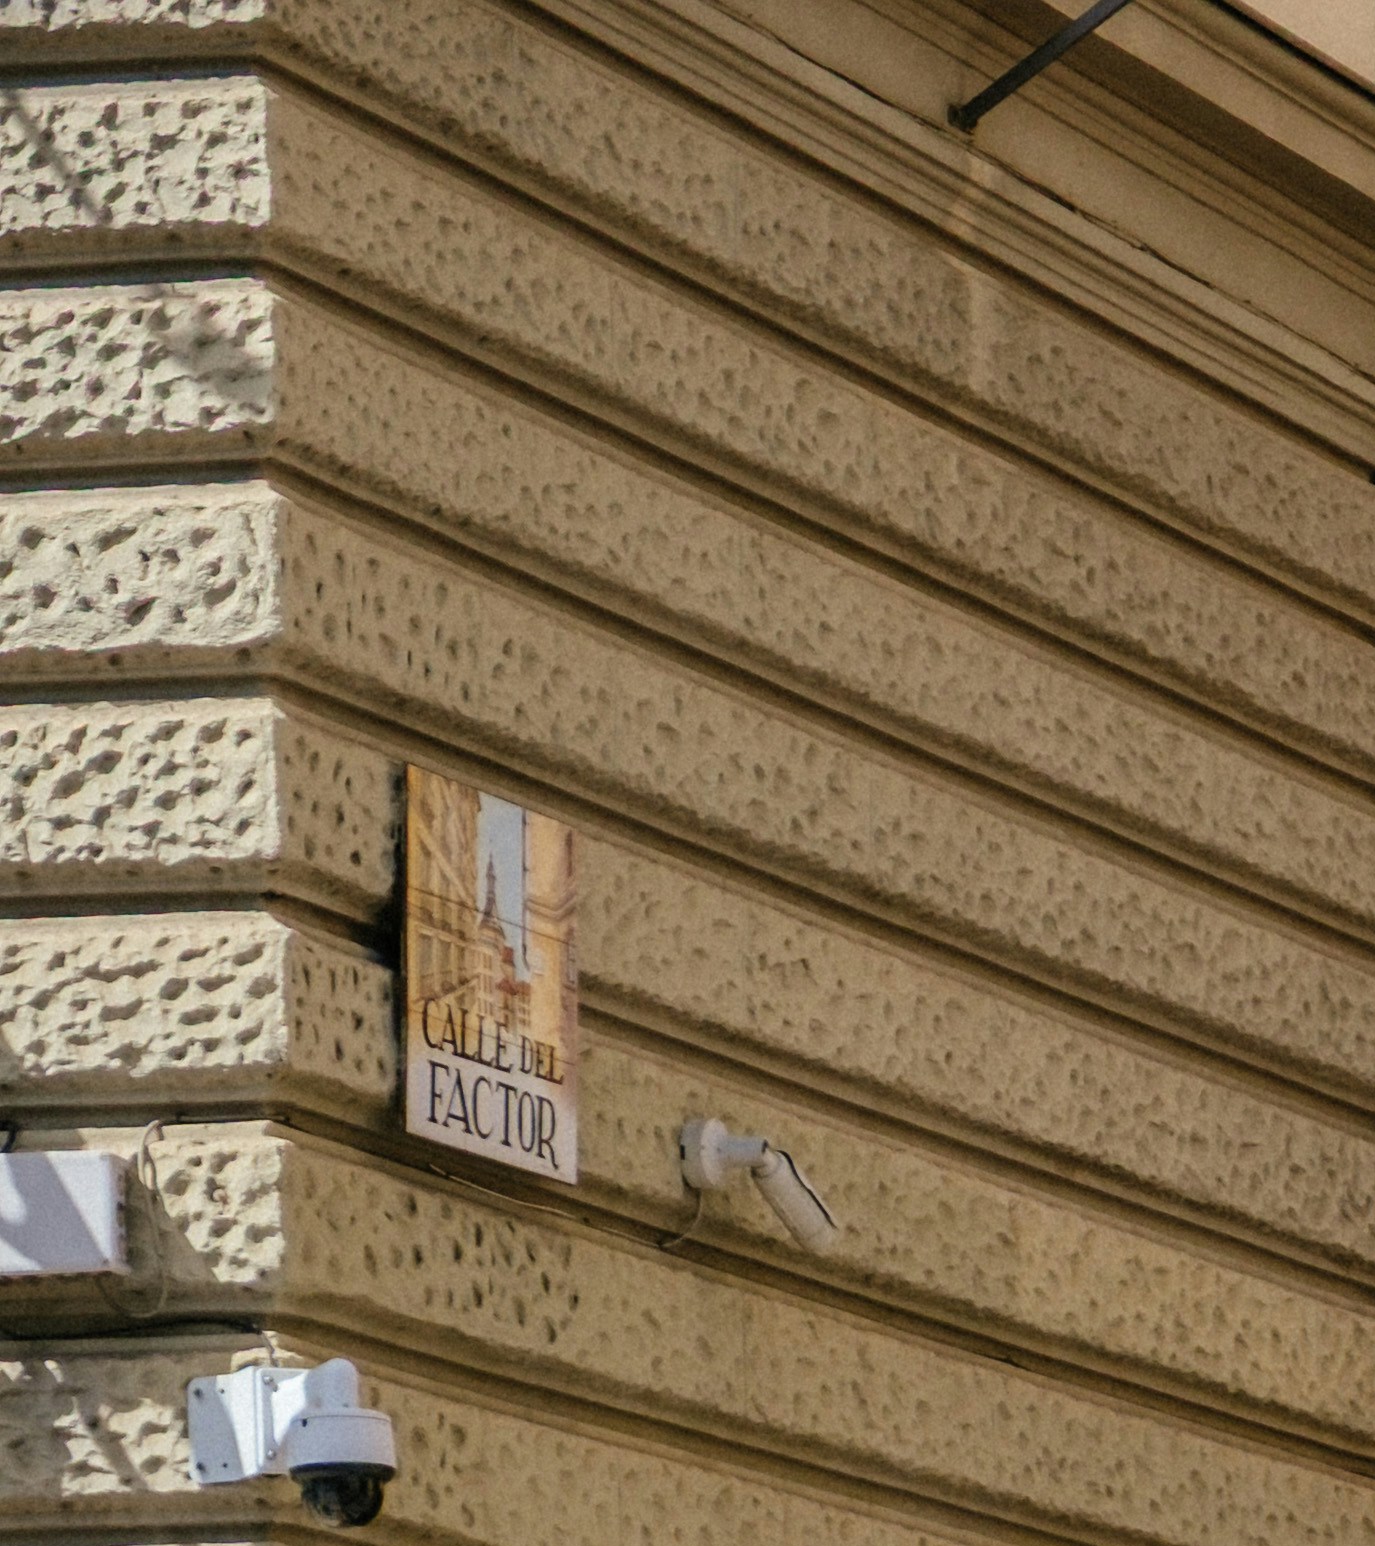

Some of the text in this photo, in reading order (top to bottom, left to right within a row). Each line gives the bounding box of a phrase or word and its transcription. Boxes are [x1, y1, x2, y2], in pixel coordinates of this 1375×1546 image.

[422, 998, 565, 1085] CALLE DEL
[427, 1059, 560, 1171] FACTOR
